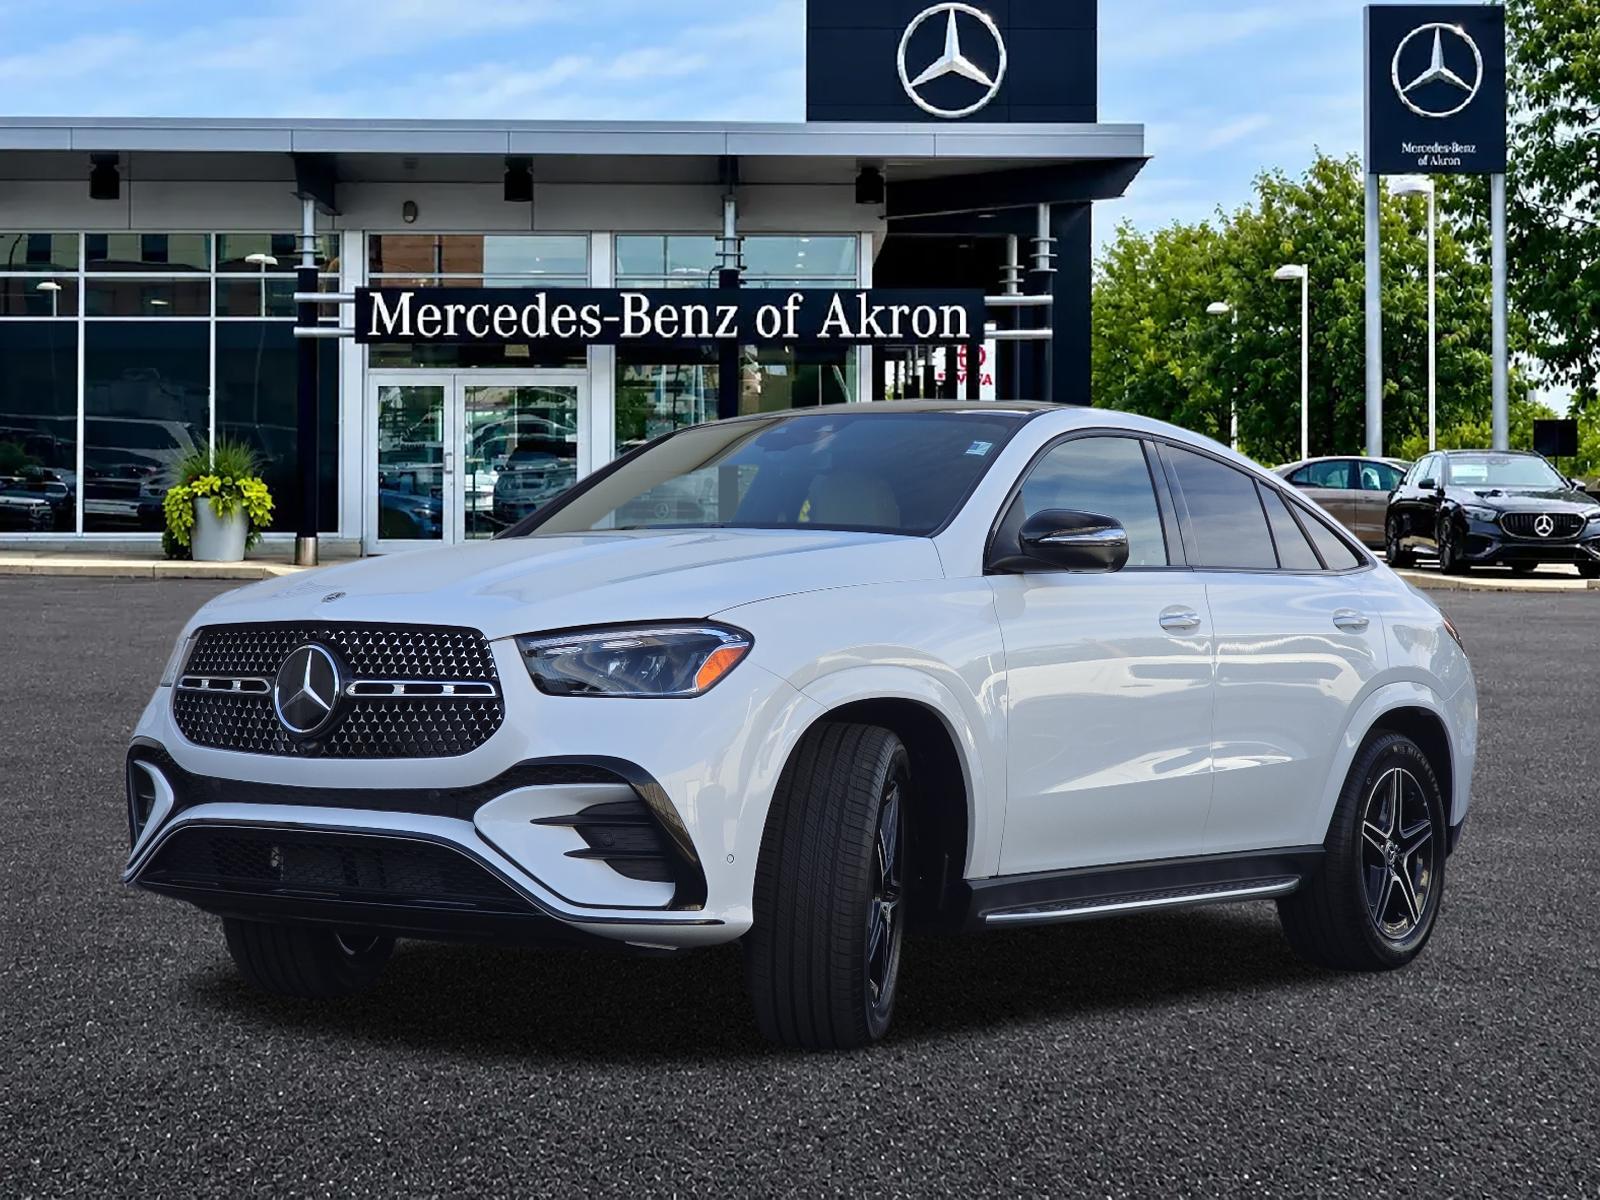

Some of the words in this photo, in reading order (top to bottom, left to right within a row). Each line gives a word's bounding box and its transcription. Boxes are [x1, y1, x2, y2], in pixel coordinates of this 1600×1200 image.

[1401, 142, 1477, 154] Mercedes-Benz
[1417, 154, 1429, 166] of
[1430, 154, 1461, 166] Akron
[367, 291, 739, 338] Mercedes-Benz
[755, 292, 804, 338] of
[816, 291, 971, 338] Akron
